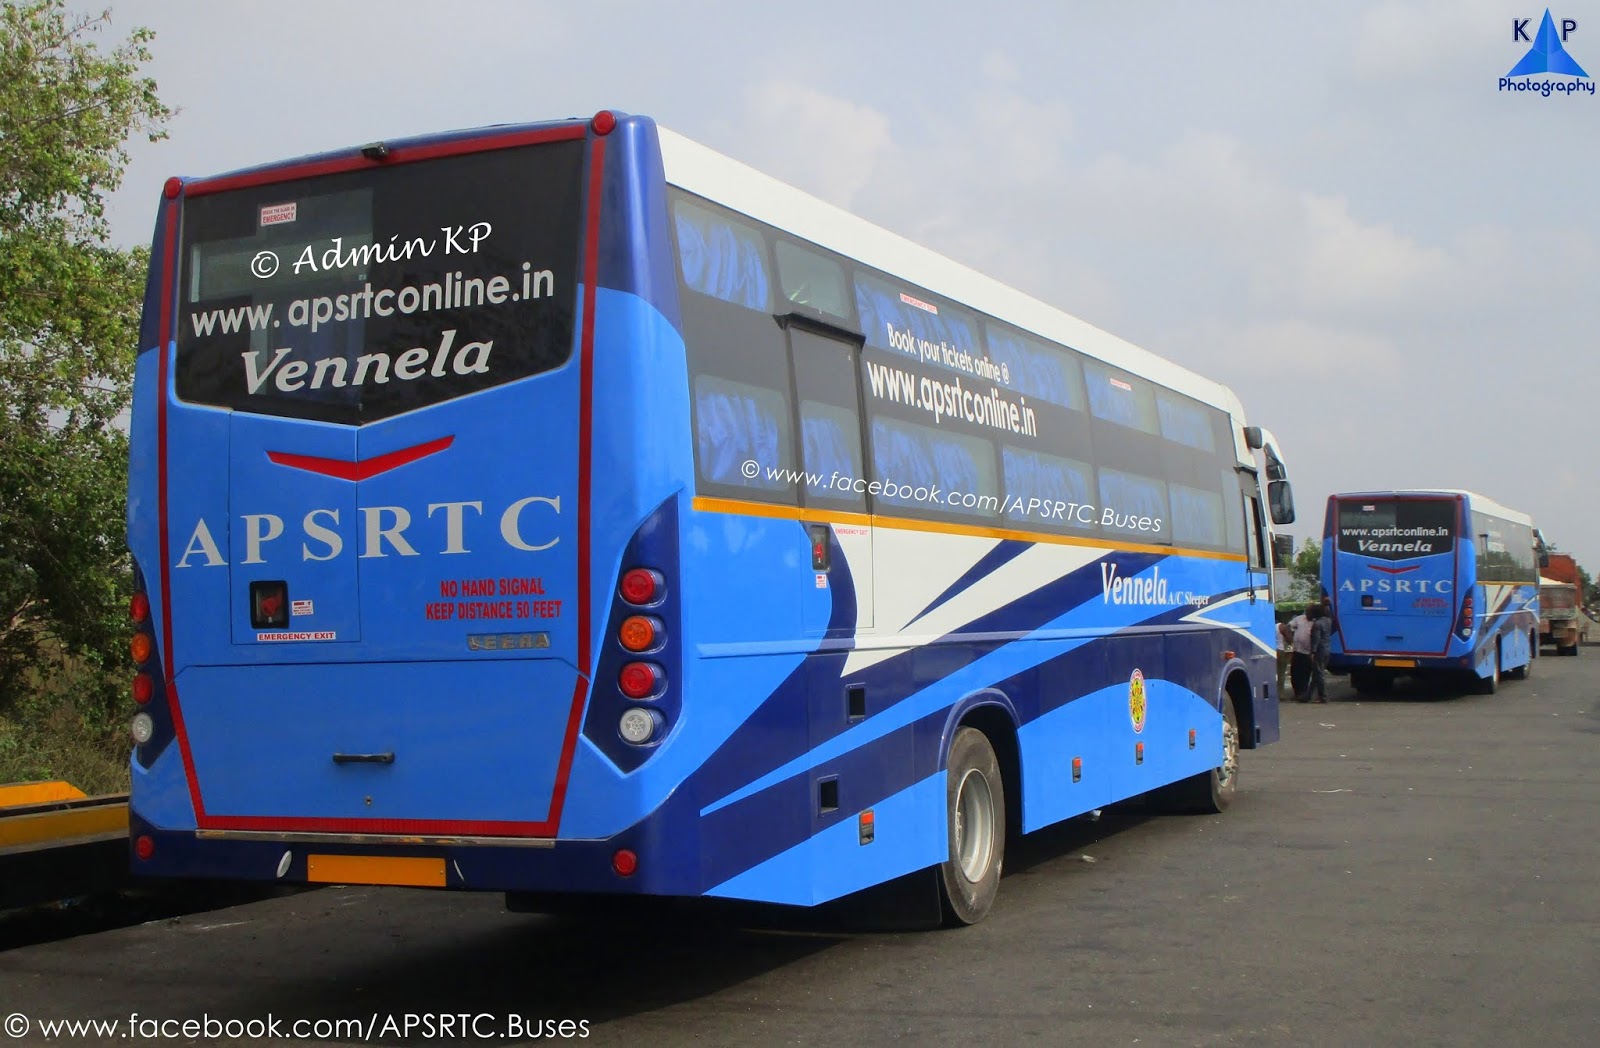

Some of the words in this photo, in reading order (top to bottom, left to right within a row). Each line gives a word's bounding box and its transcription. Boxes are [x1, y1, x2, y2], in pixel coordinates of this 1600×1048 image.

[262, 212, 295, 224] EMERGENCY
[886, 322, 917, 355] Book
[917, 338, 941, 363] your
[941, 341, 973, 374] tickets
[974, 356, 1001, 382] online
[241, 329, 495, 396] Vennela
[866, 361, 1037, 438] www.apsrtconline.in
[175, 495, 562, 569] APSRTC
[1341, 526, 1449, 538] www.apsrtconline.in
[1357, 539, 1433, 552] Vennela
[440, 580, 458, 597] NO
[461, 579, 495, 596] HAND
[499, 577, 545, 595] SIGNAL
[1100, 562, 1168, 606] Vennela
[1167, 591, 1184, 606] A/C
[1184, 591, 1210, 609] Sleeper
[1339, 578, 1452, 594] APSRTC
[425, 602, 455, 619] KEEP
[457, 601, 513, 619] DISTANCE
[516, 601, 530, 618] 50
[533, 600, 562, 618] FEET
[258, 633, 312, 641] EMERGENCY
